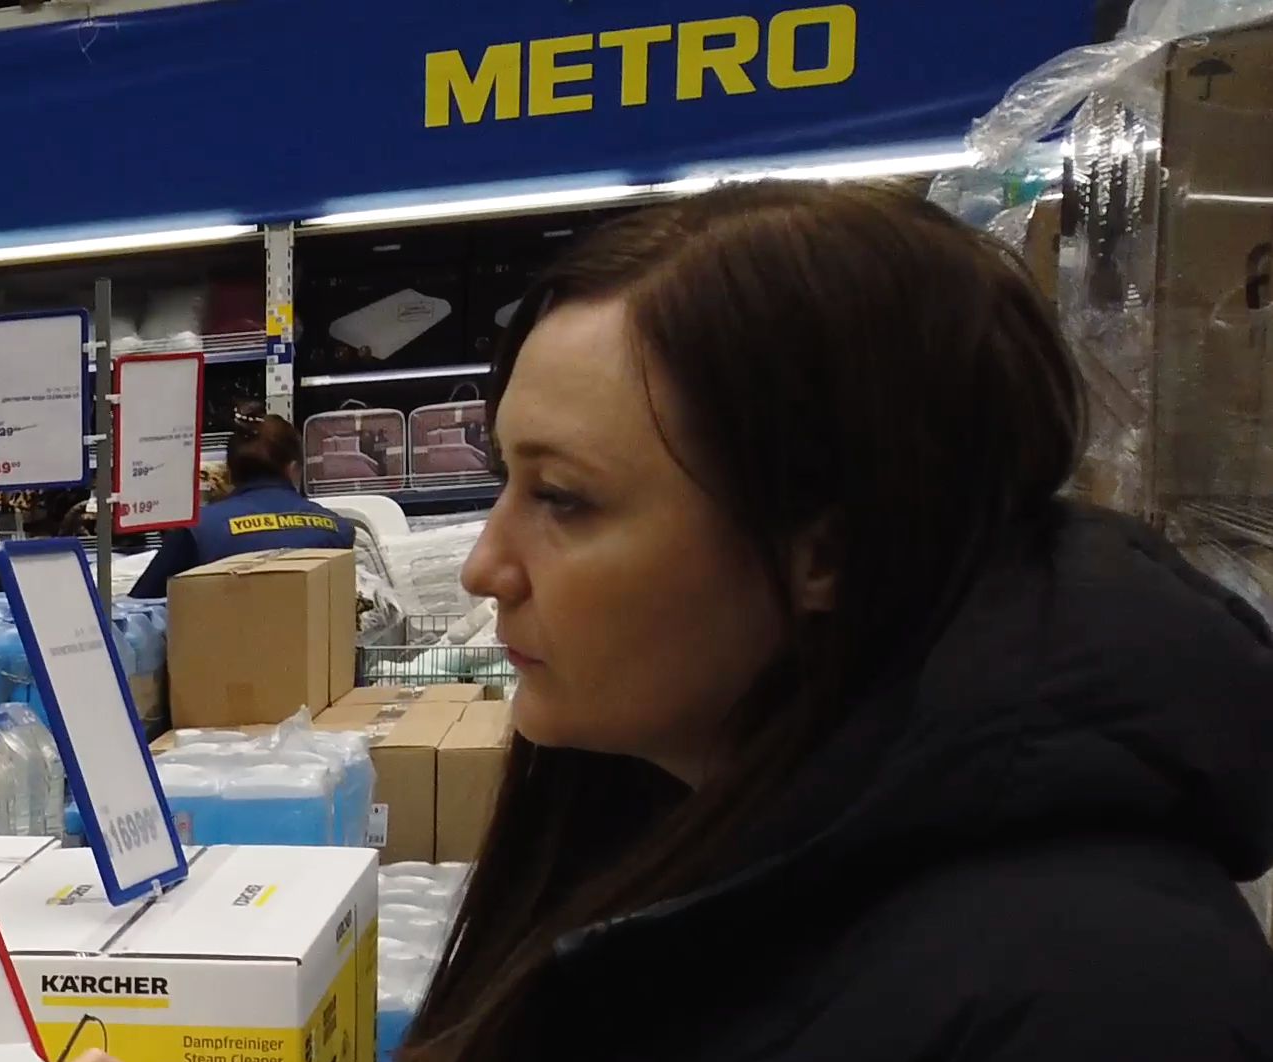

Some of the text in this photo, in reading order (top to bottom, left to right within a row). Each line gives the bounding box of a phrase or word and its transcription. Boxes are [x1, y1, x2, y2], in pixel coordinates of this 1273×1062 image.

[424, 4, 857, 128] METRO
[233, 515, 334, 531] YOU & METRO
[41, 974, 168, 995] KÄRCHER
[183, 1034, 284, 1054] Dampfreiniger
